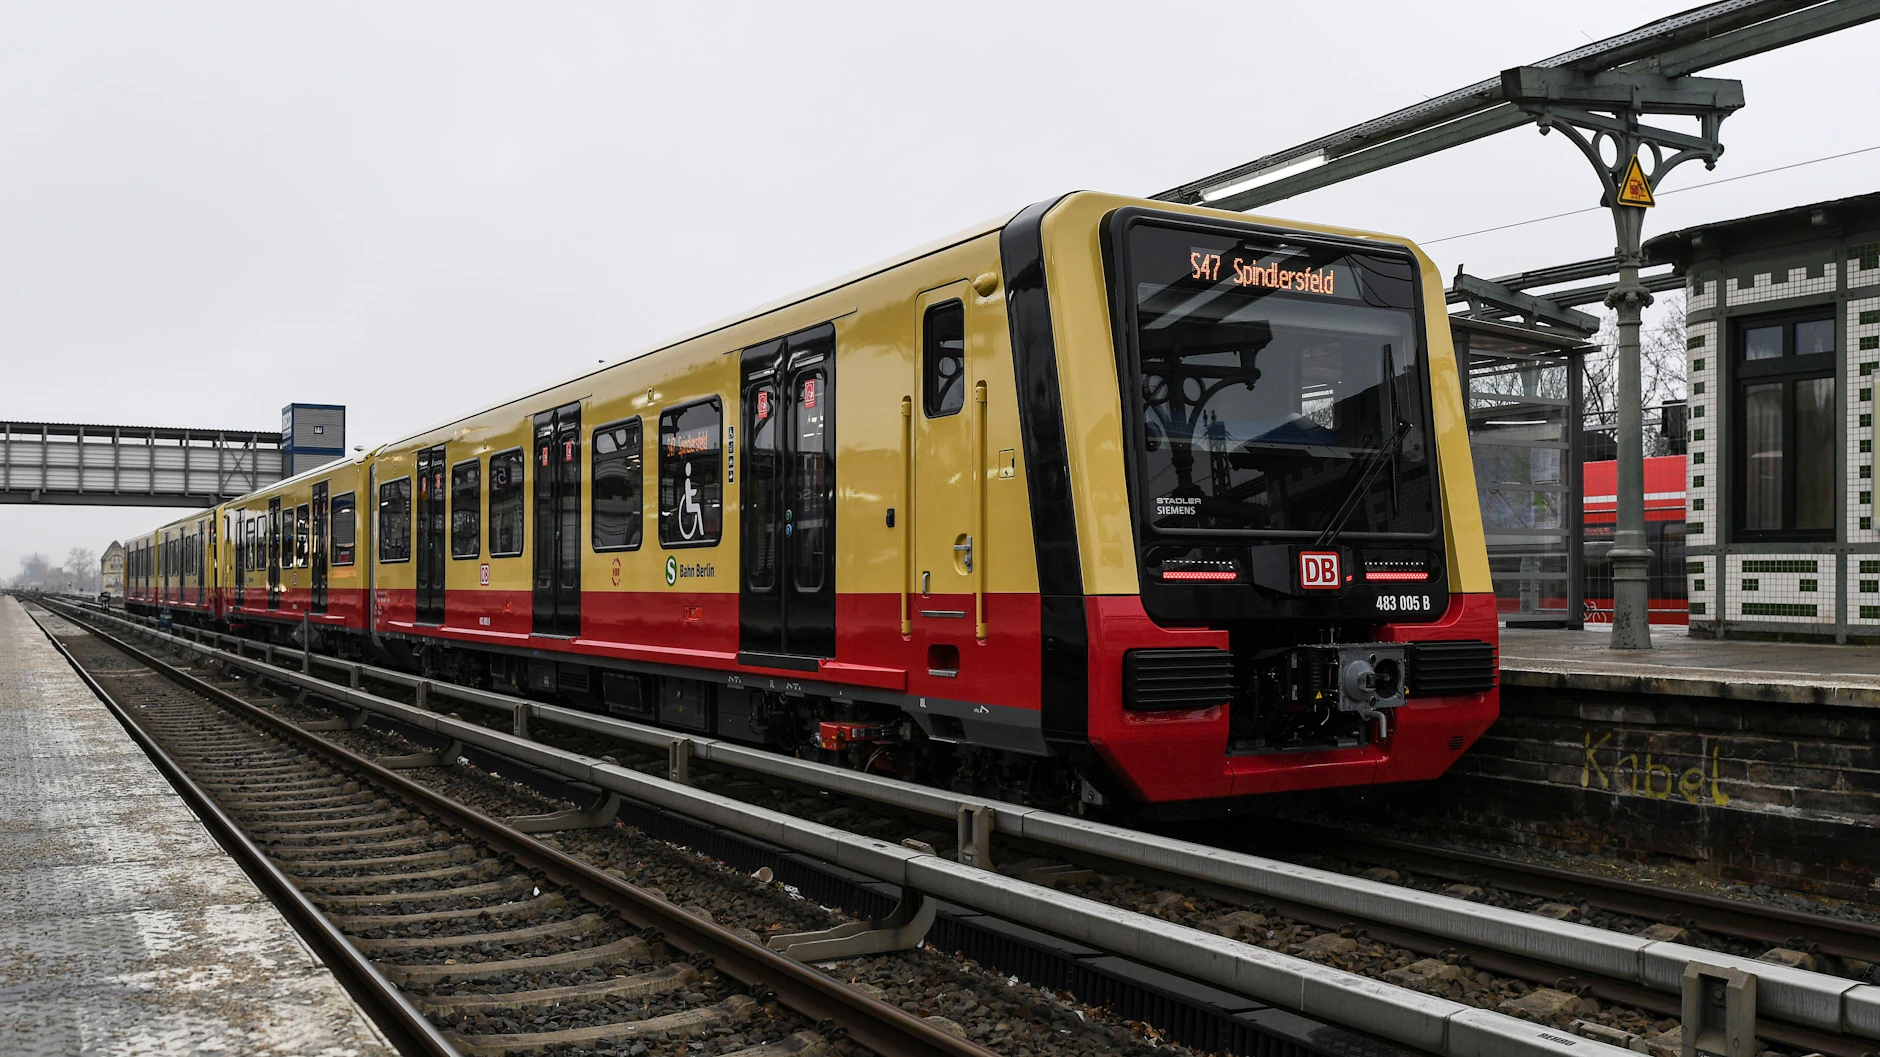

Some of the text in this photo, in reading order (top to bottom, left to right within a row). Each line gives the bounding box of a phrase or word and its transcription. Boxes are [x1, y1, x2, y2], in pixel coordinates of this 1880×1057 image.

[1190, 252, 1335, 295] S47 Spindlersfeld
[1157, 506, 1196, 514] SIEMENS
[680, 565, 694, 578] Bahn
[696, 564, 714, 578] Berlin
[1304, 558, 1336, 583] DB
[1376, 595, 1430, 612] 483 005 B
